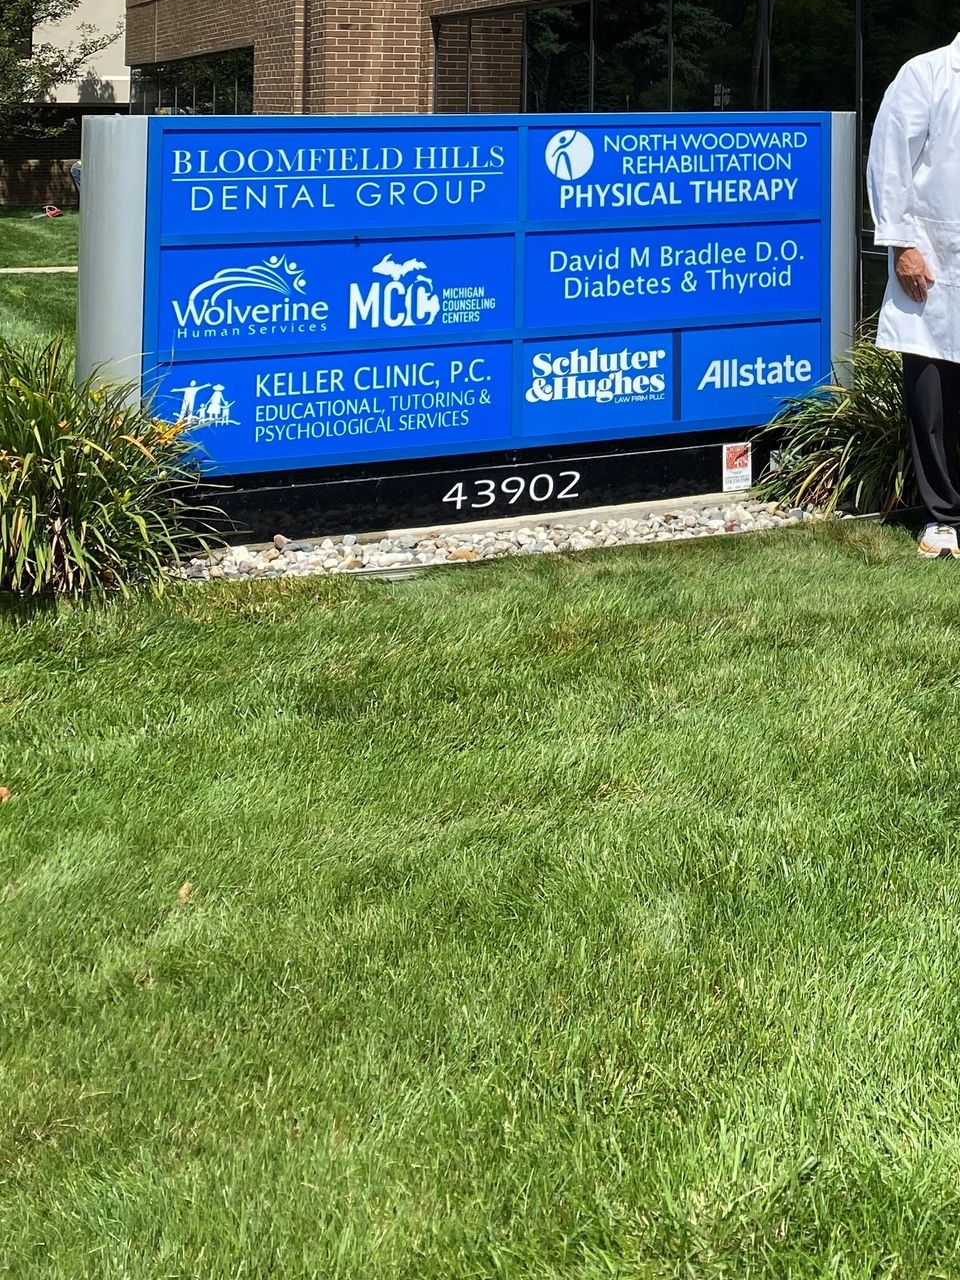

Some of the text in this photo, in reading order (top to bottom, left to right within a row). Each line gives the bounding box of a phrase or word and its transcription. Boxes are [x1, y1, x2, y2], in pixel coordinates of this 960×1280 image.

[604, 132, 807, 152] NORTH WOODWARD
[172, 146, 505, 175] BLOOMFIELD HILLS
[622, 153, 792, 175] REHABILITATION
[191, 179, 486, 211] DENTAL GROUP
[560, 178, 798, 208] PHYSICAL THERAPY
[550, 240, 804, 272] David M Bradlee D.O.
[442, 287, 485, 299] MICHIGAN
[564, 265, 791, 299] Diabetes & Thyroid
[171, 298, 328, 327] Wolverine
[442, 298, 496, 312] COUNSELING
[442, 311, 480, 324] CENTERS
[177, 322, 327, 339] Human Services
[256, 358, 491, 397] KELLER CLINIC, P.C.
[531, 347, 666, 378] Schluter
[697, 355, 812, 390] Allstate
[255, 388, 491, 423] EDUCATIONAL, TUTORING &
[255, 410, 469, 442] PSYCHOLOGICAL SERVICES
[442, 471, 580, 509] 43902
